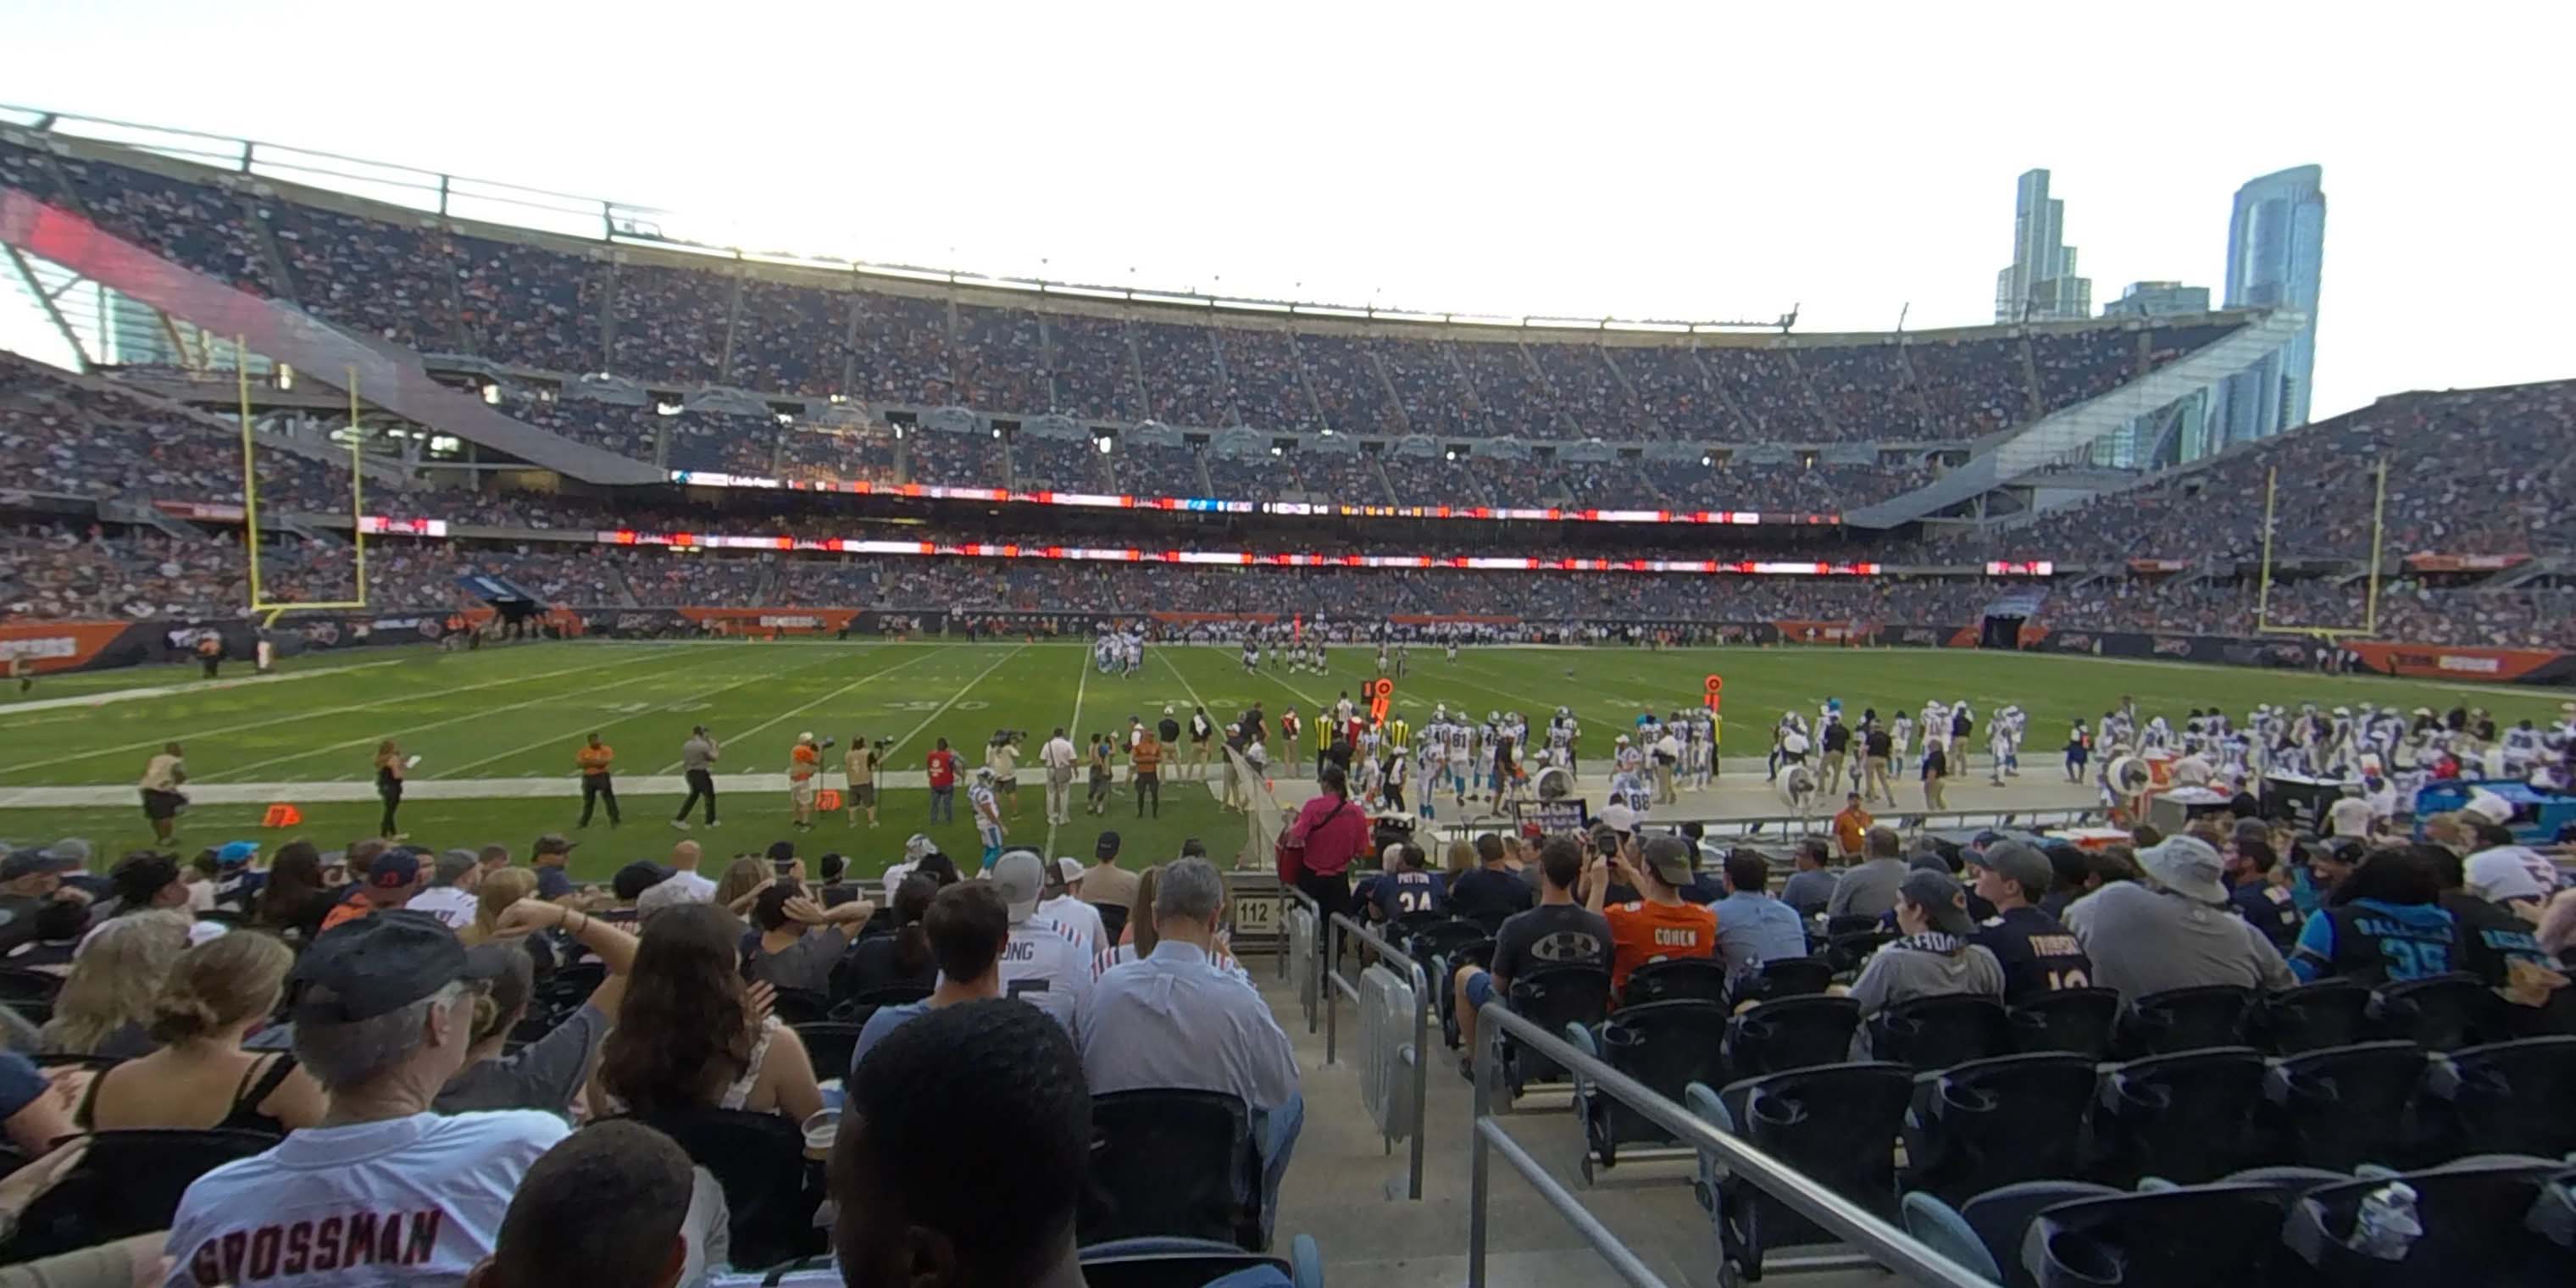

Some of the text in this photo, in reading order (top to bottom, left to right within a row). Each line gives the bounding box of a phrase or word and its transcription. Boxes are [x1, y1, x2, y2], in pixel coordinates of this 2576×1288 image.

[1452, 733, 1467, 748] 81
[1630, 794, 1651, 812] 88
[1241, 902, 1268, 922] 112
[1655, 928, 1696, 947] COHEN
[2379, 937, 2447, 981] 35
[191, 1208, 443, 1287] GROSSMAN
